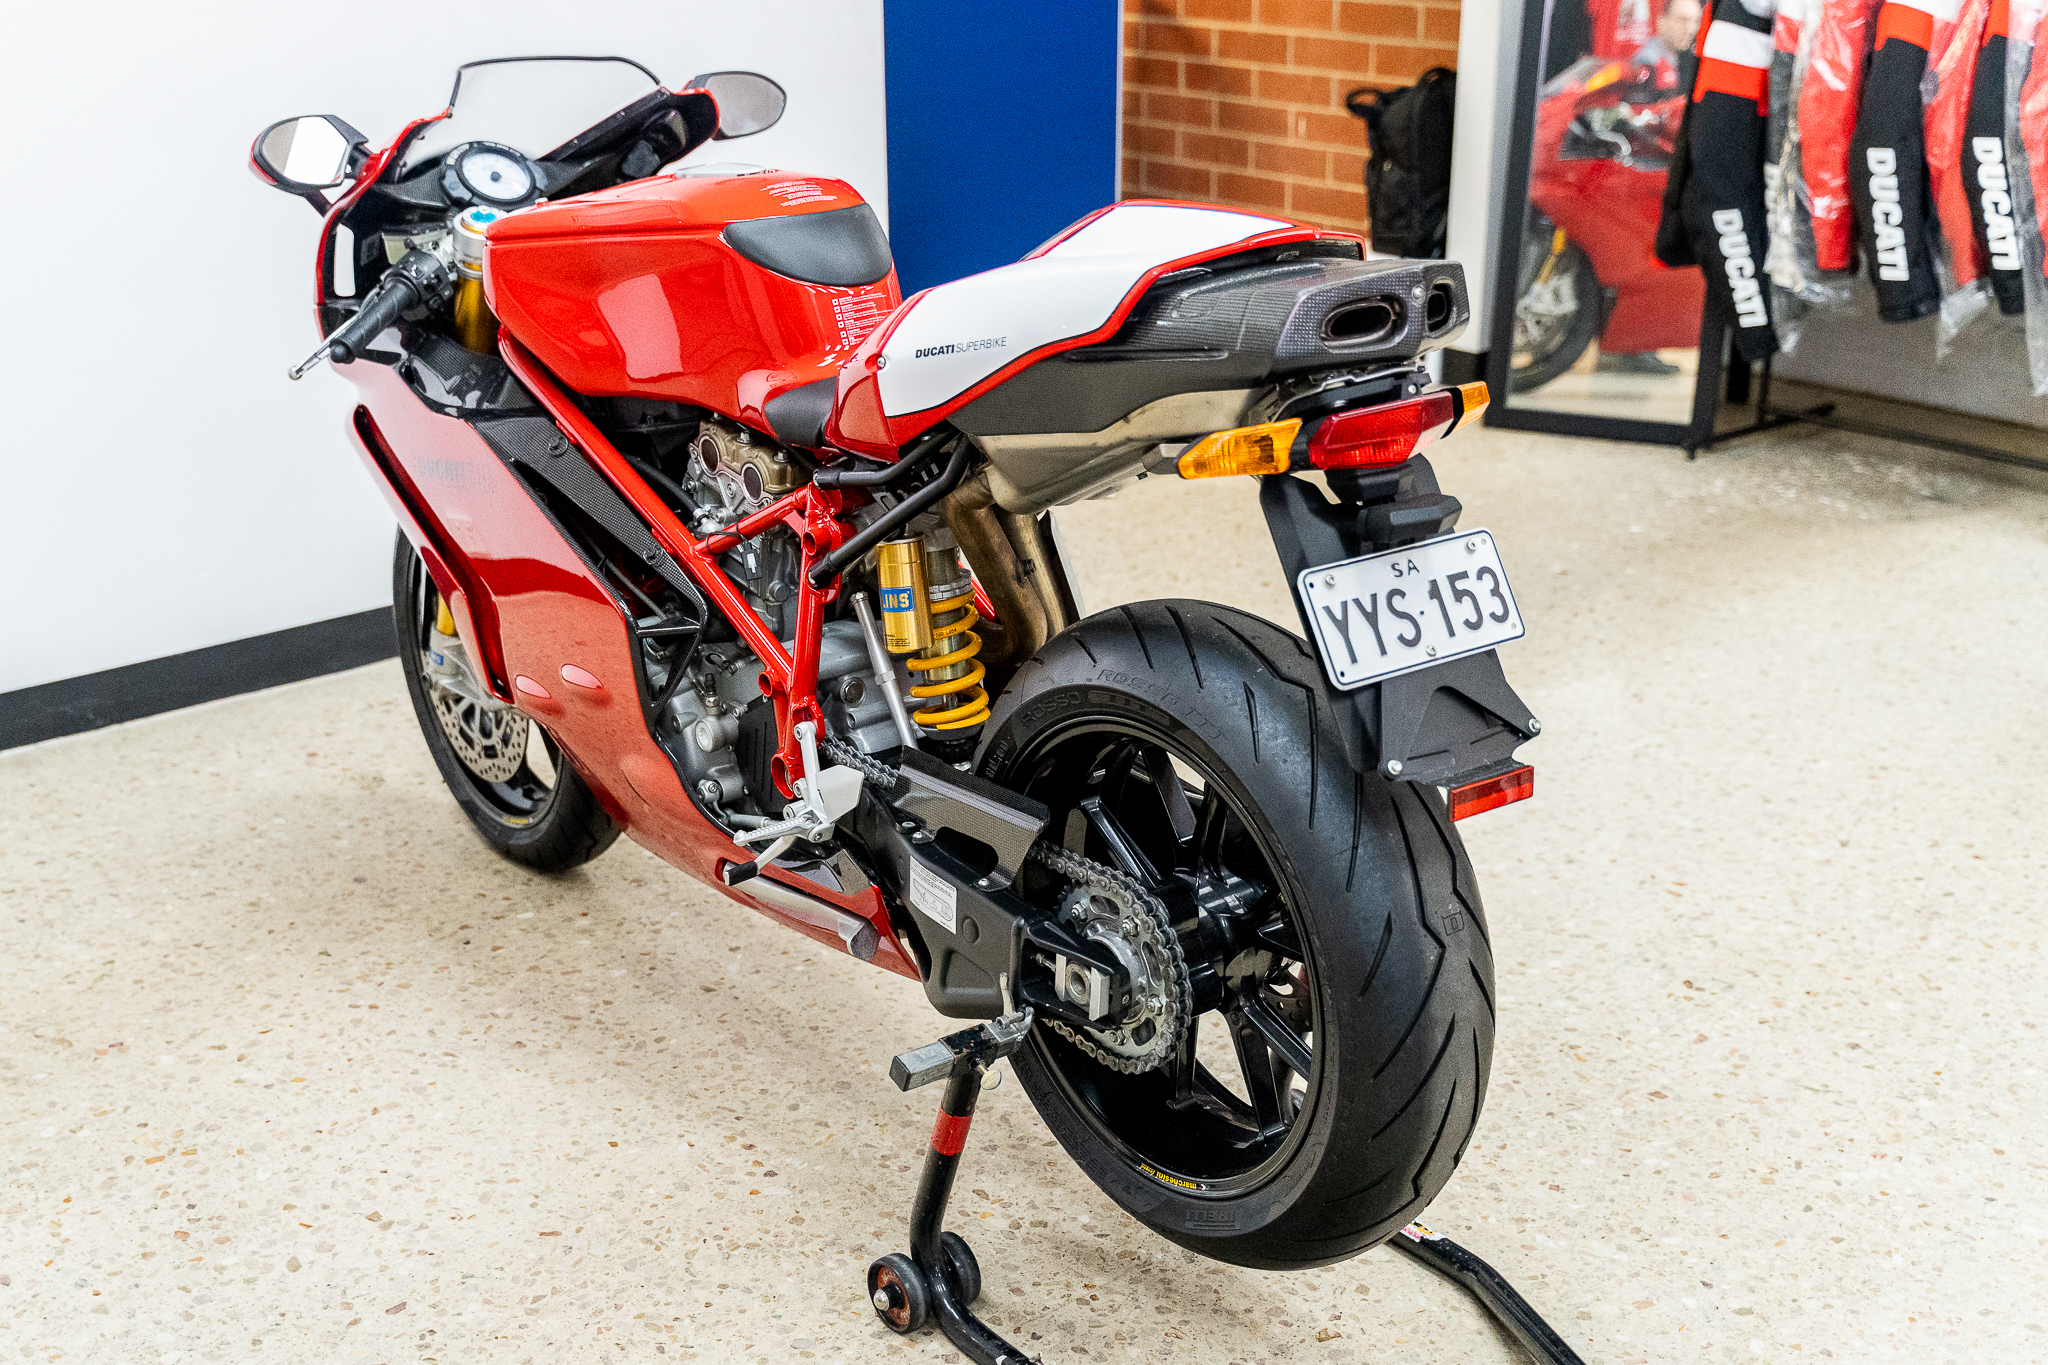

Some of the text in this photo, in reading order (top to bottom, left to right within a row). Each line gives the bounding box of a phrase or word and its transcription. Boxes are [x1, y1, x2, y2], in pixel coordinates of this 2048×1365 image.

[1865, 147, 1911, 282] DUCATI
[1971, 136, 2022, 271] DUCATI
[1711, 207, 1769, 329] DUCATI
[914, 336, 1008, 359] DUCATI SUPERBIKE
[418, 456, 467, 483] DUCATI
[1390, 558, 1420, 578] SA
[1097, 668, 1179, 707] ROSSO
[1155, 1171, 1197, 1190] marchesini
